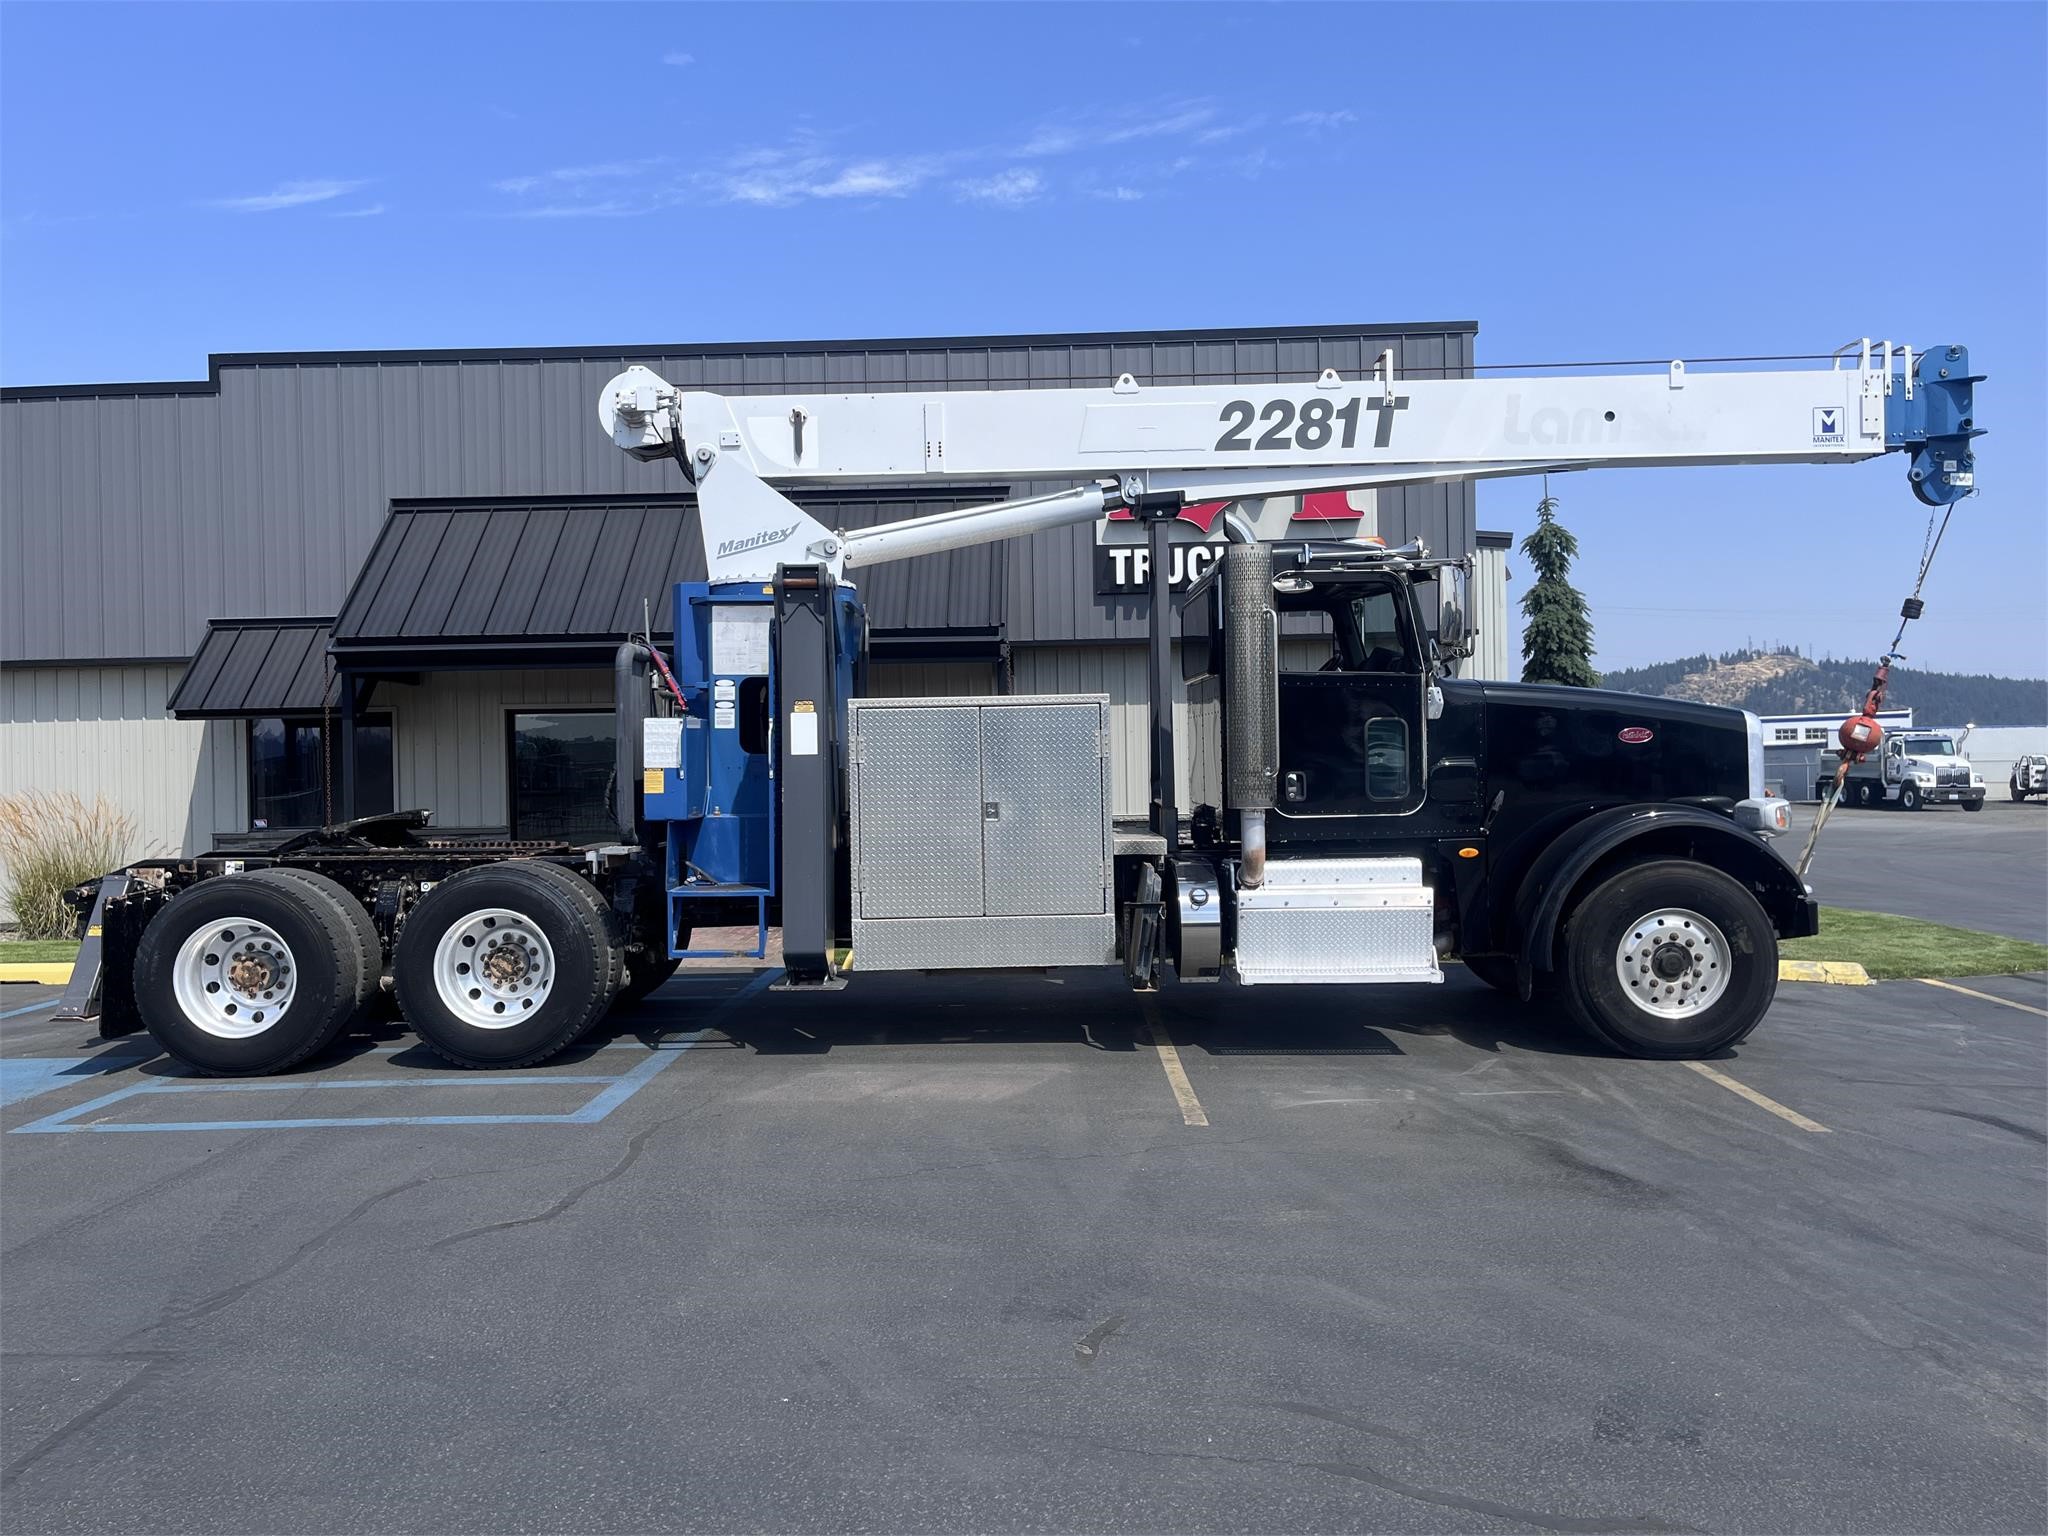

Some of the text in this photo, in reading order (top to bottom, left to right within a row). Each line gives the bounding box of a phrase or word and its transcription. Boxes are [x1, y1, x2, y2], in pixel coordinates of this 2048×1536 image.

[1214, 396, 1410, 451] 2281T
[717, 527, 789, 555] Manitex
[1109, 546, 1225, 585] TRUC
